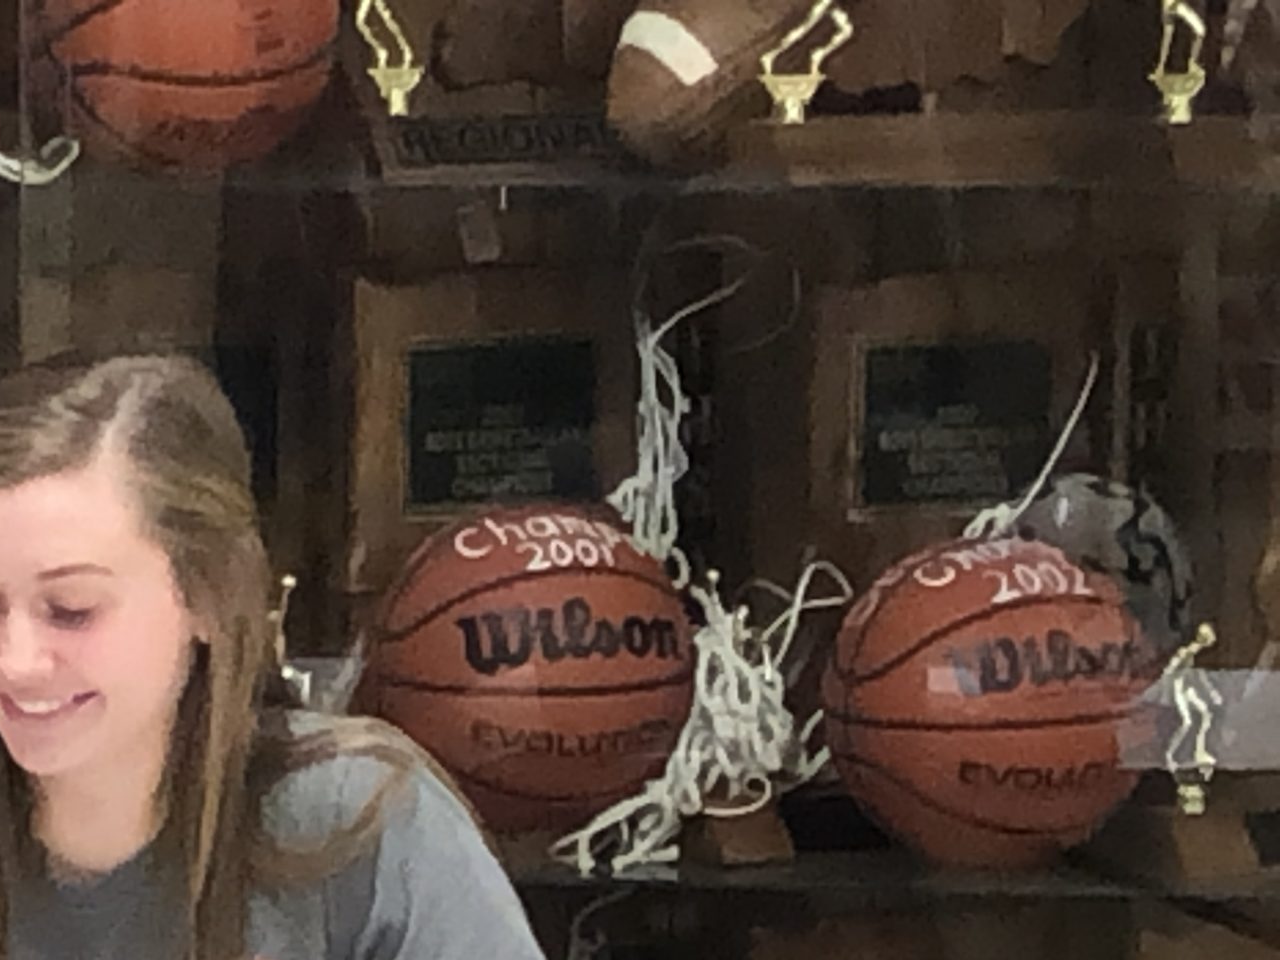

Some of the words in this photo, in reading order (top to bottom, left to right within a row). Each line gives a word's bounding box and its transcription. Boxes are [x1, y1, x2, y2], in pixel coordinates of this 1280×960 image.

[516, 539, 616, 571] 2001
[981, 560, 1096, 604] 2002
[456, 597, 684, 677] Wilson
